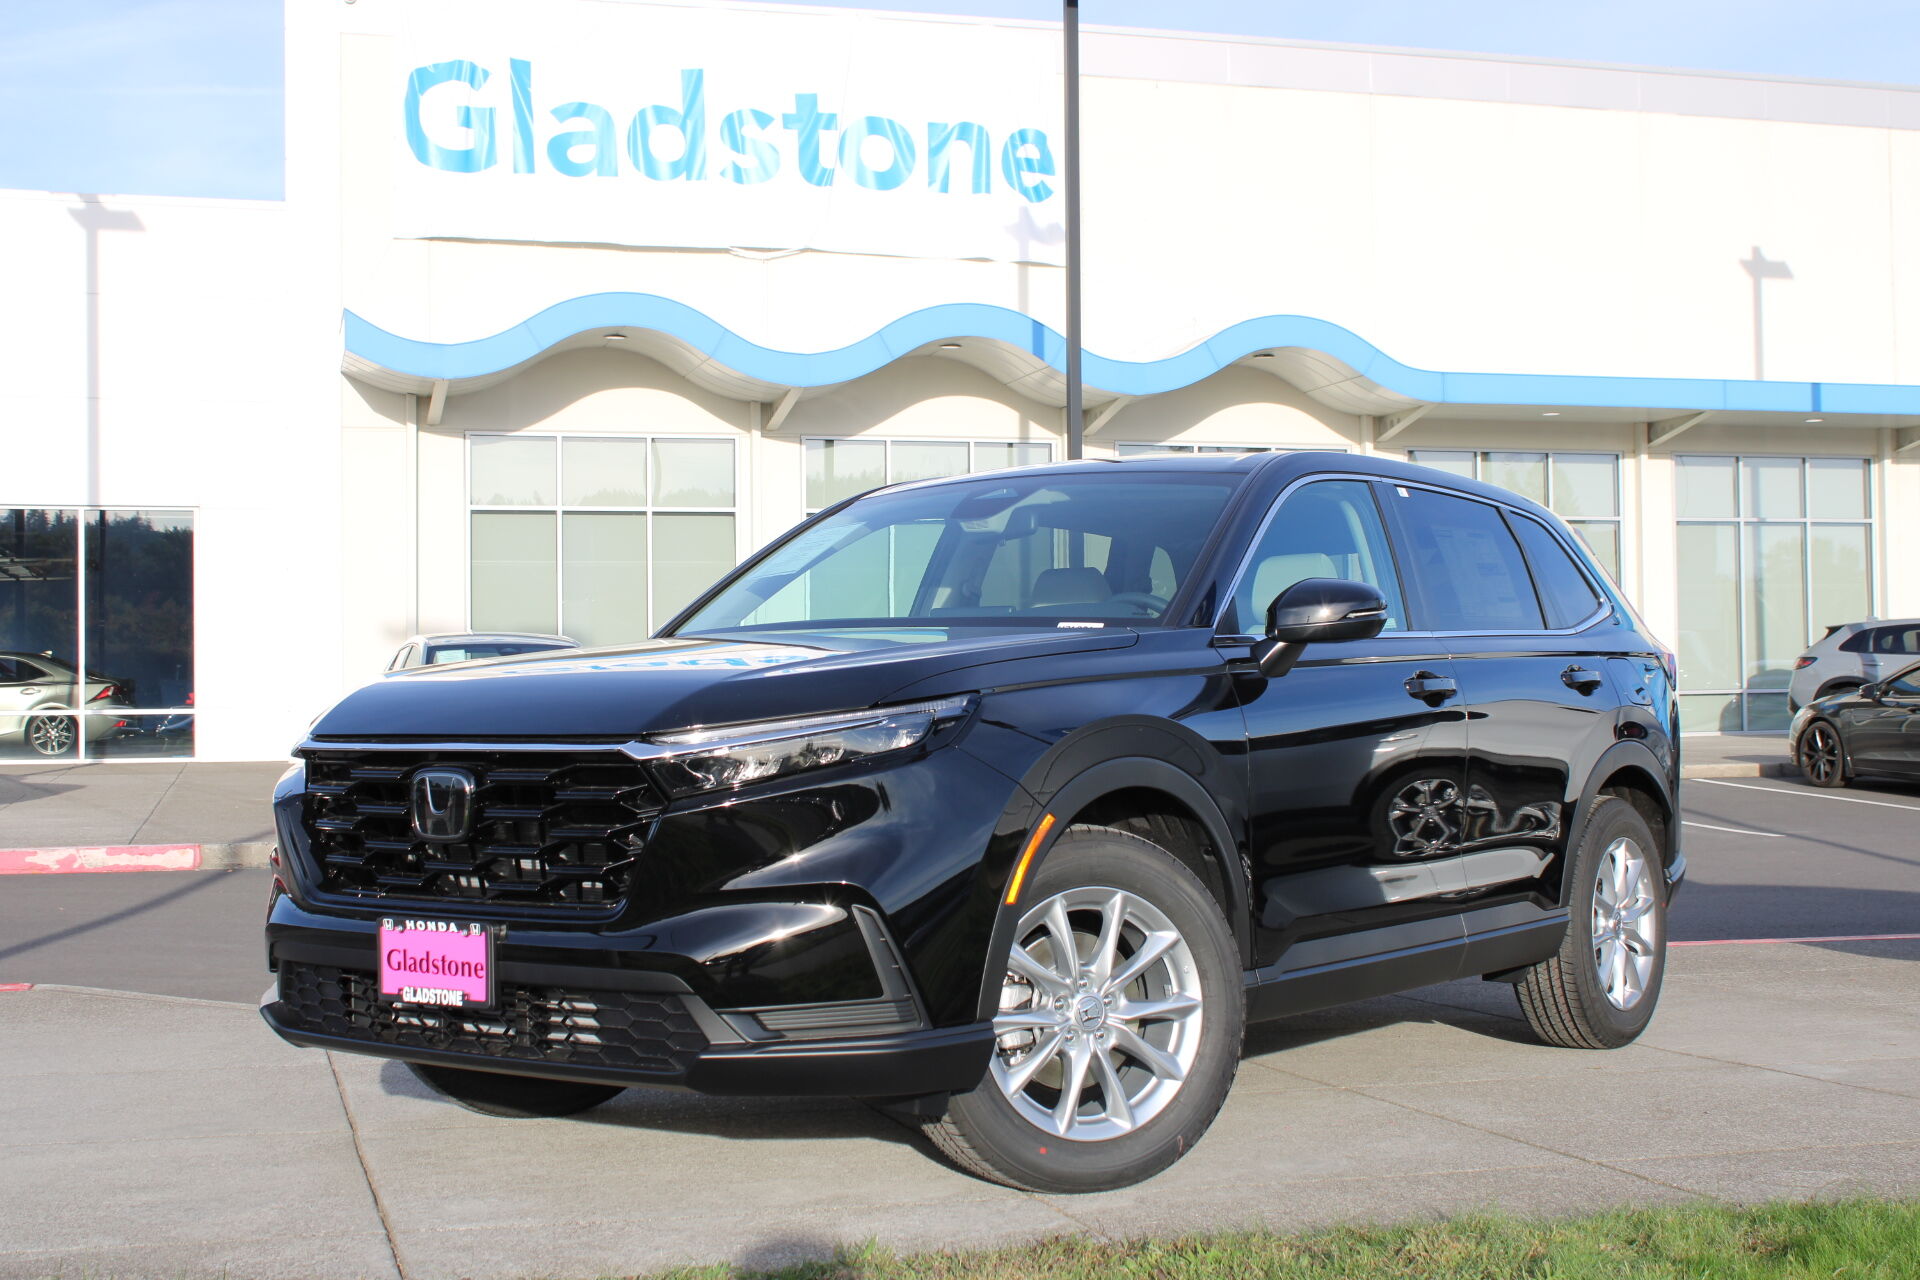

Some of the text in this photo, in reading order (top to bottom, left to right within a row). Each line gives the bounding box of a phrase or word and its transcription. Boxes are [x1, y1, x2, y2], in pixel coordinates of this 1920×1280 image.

[405, 58, 1055, 202] Gladstone
[405, 920, 458, 932] HONDA
[387, 949, 484, 978] Gladstone
[402, 986, 463, 1006] GLADSTONE
